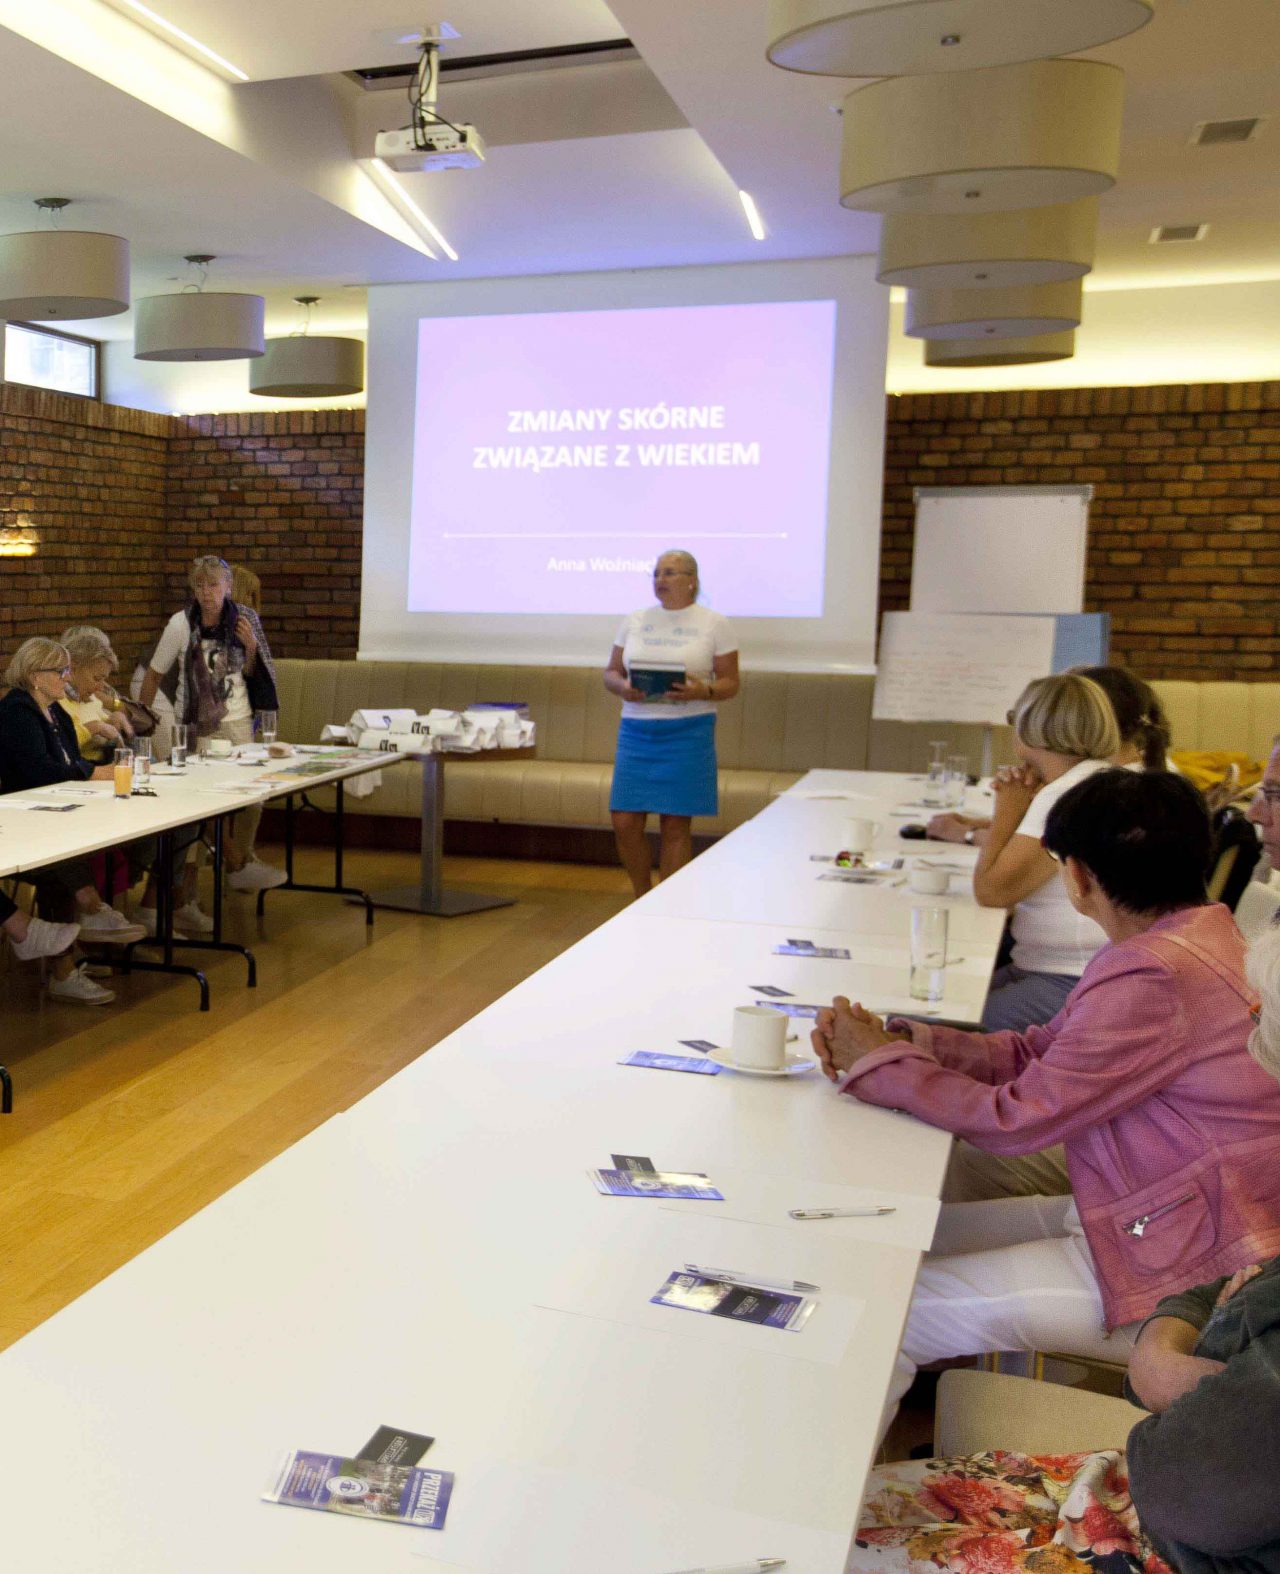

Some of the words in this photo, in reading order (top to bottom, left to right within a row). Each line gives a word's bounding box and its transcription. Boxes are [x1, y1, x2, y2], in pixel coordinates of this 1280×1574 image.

[507, 409, 612, 432] ZMIANY
[618, 402, 725, 430] SKÓRNE
[472, 445, 608, 472] ZWIĄZANE
[615, 445, 630, 466] Z
[637, 442, 760, 466] WIEKIEM
[547, 557, 585, 572] Anna
